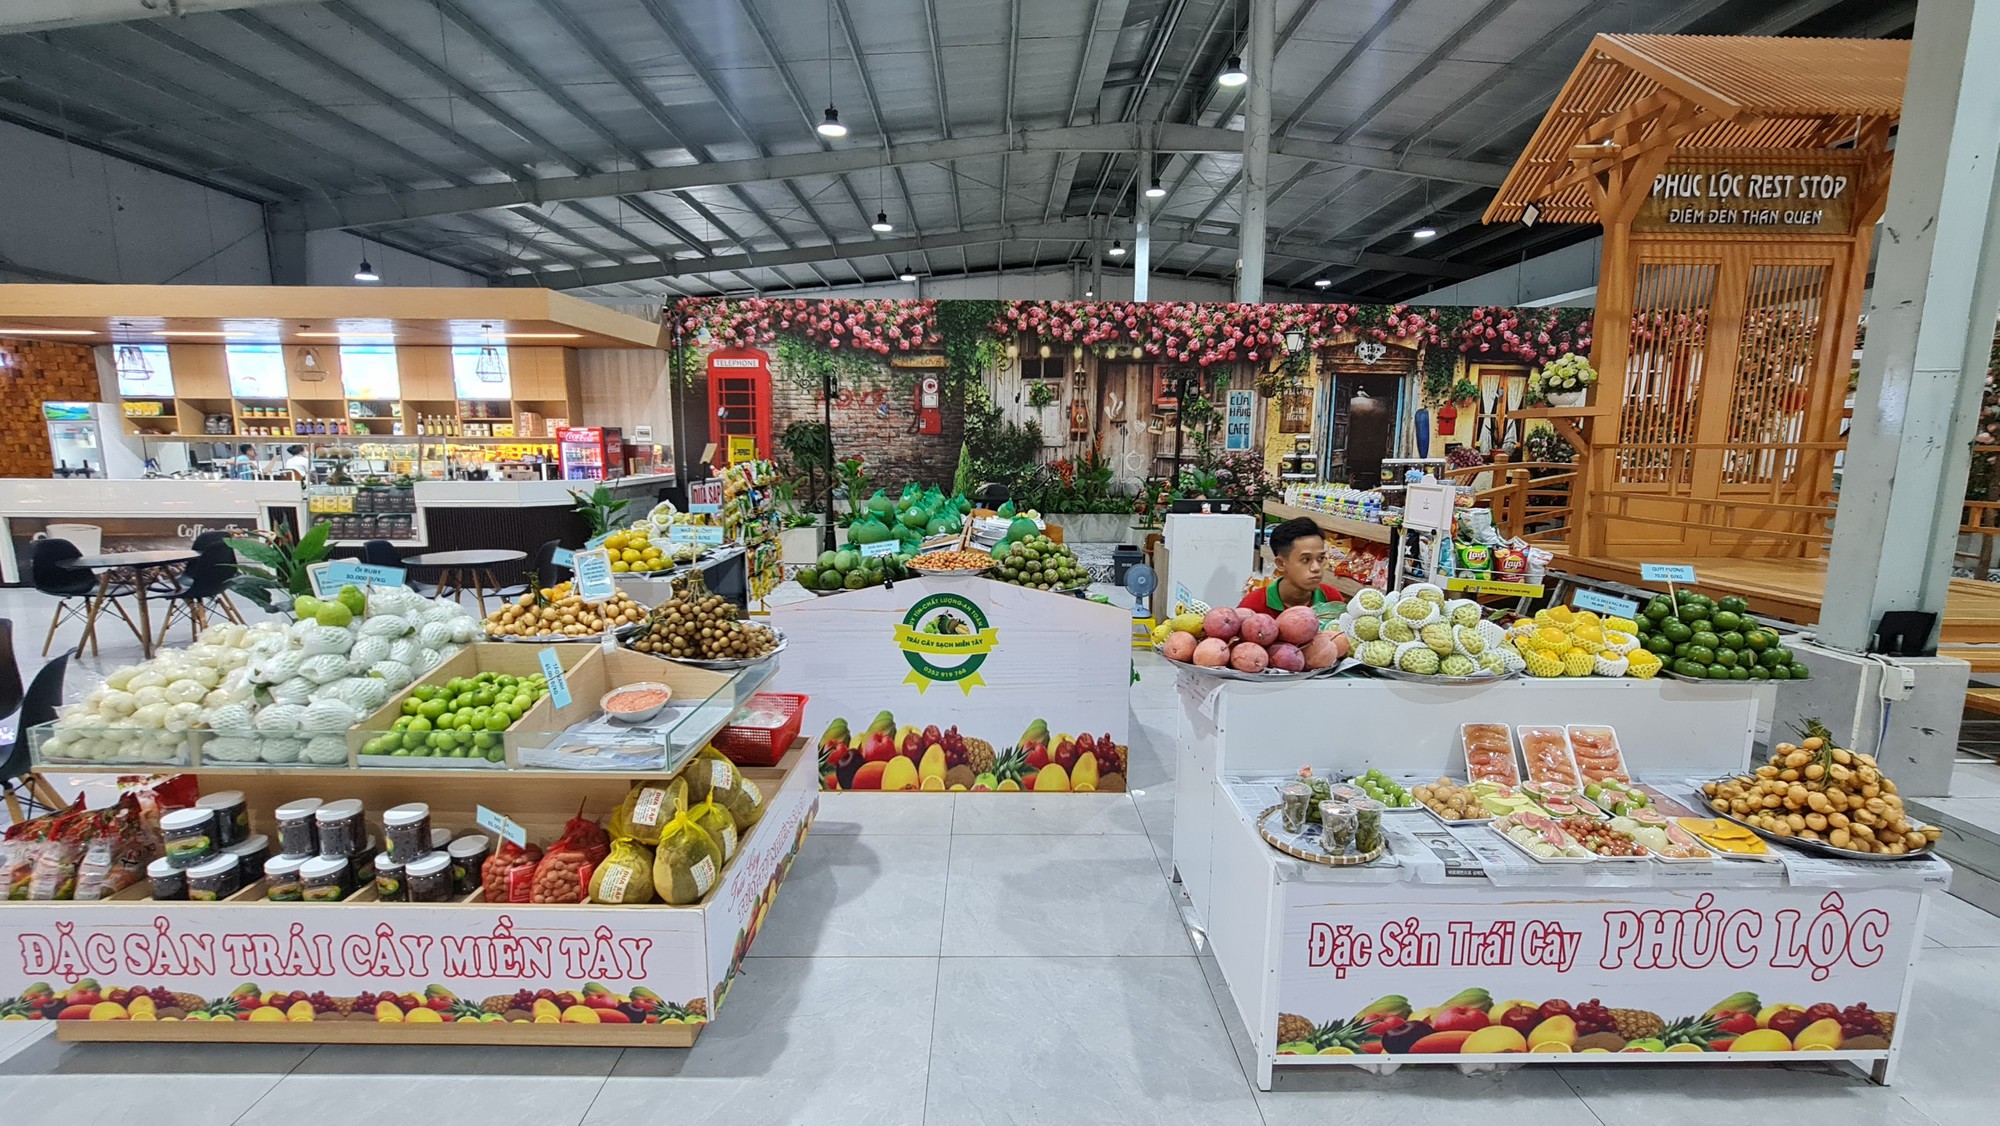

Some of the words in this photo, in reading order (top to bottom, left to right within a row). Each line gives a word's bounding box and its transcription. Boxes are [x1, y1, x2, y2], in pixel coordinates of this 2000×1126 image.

[1653, 168, 1702, 198] PHÚC
[1709, 169, 1743, 202] LỘC
[1748, 174, 1795, 199] REST
[1799, 174, 1847, 199] STOP
[1784, 210, 1823, 225] QUEN
[715, 359, 759, 368] TELEPHONE
[906, 636, 920, 645] TRÁI
[921, 637, 935, 647] CÂY
[936, 641, 954, 650] SẠCH
[971, 636, 984, 645] TÂY
[923, 666, 940, 677] 0352
[1308, 922, 1373, 980] Đặc
[1378, 916, 1441, 967] Sản
[1448, 920, 1516, 966] Trái
[1521, 919, 1583, 973] Cây
[1599, 892, 1763, 970] PHÚC
[1769, 890, 1890, 982] LỘC
[18, 921, 117, 984] ĐẶC
[124, 915, 216, 976] SẢN
[222, 922, 336, 977] TRÁI
[341, 922, 433, 977] CÂY
[441, 914, 553, 979] MIỀN
[559, 925, 653, 980] TÂY
